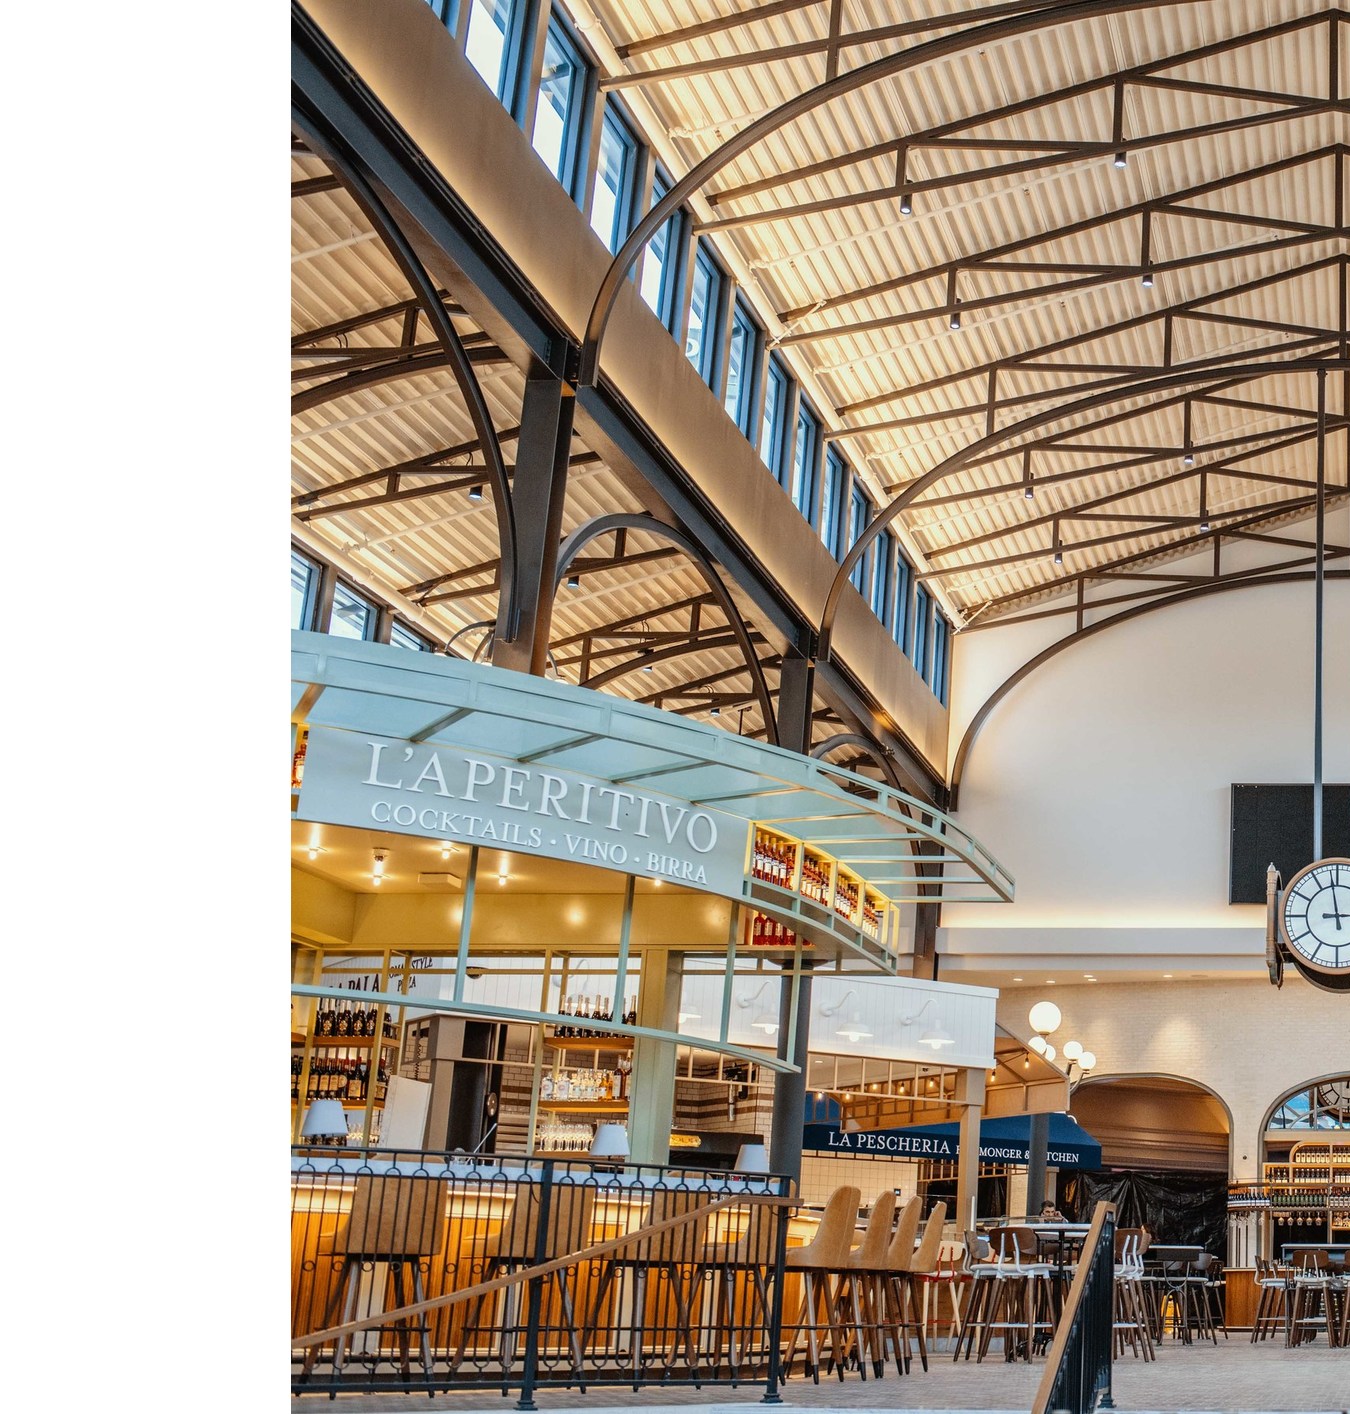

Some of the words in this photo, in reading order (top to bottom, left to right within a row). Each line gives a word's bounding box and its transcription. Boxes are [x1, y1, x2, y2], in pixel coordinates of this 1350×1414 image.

[361, 741, 718, 853] L’APERITIVO
[371, 801, 542, 848] COCKTAILS
[563, 833, 628, 864] VINO
[646, 851, 708, 885] BIRRA
[828, 1131, 852, 1147] LA
[856, 1133, 951, 1155] PESCHERIA
[1024, 1150, 1030, 1159] &
